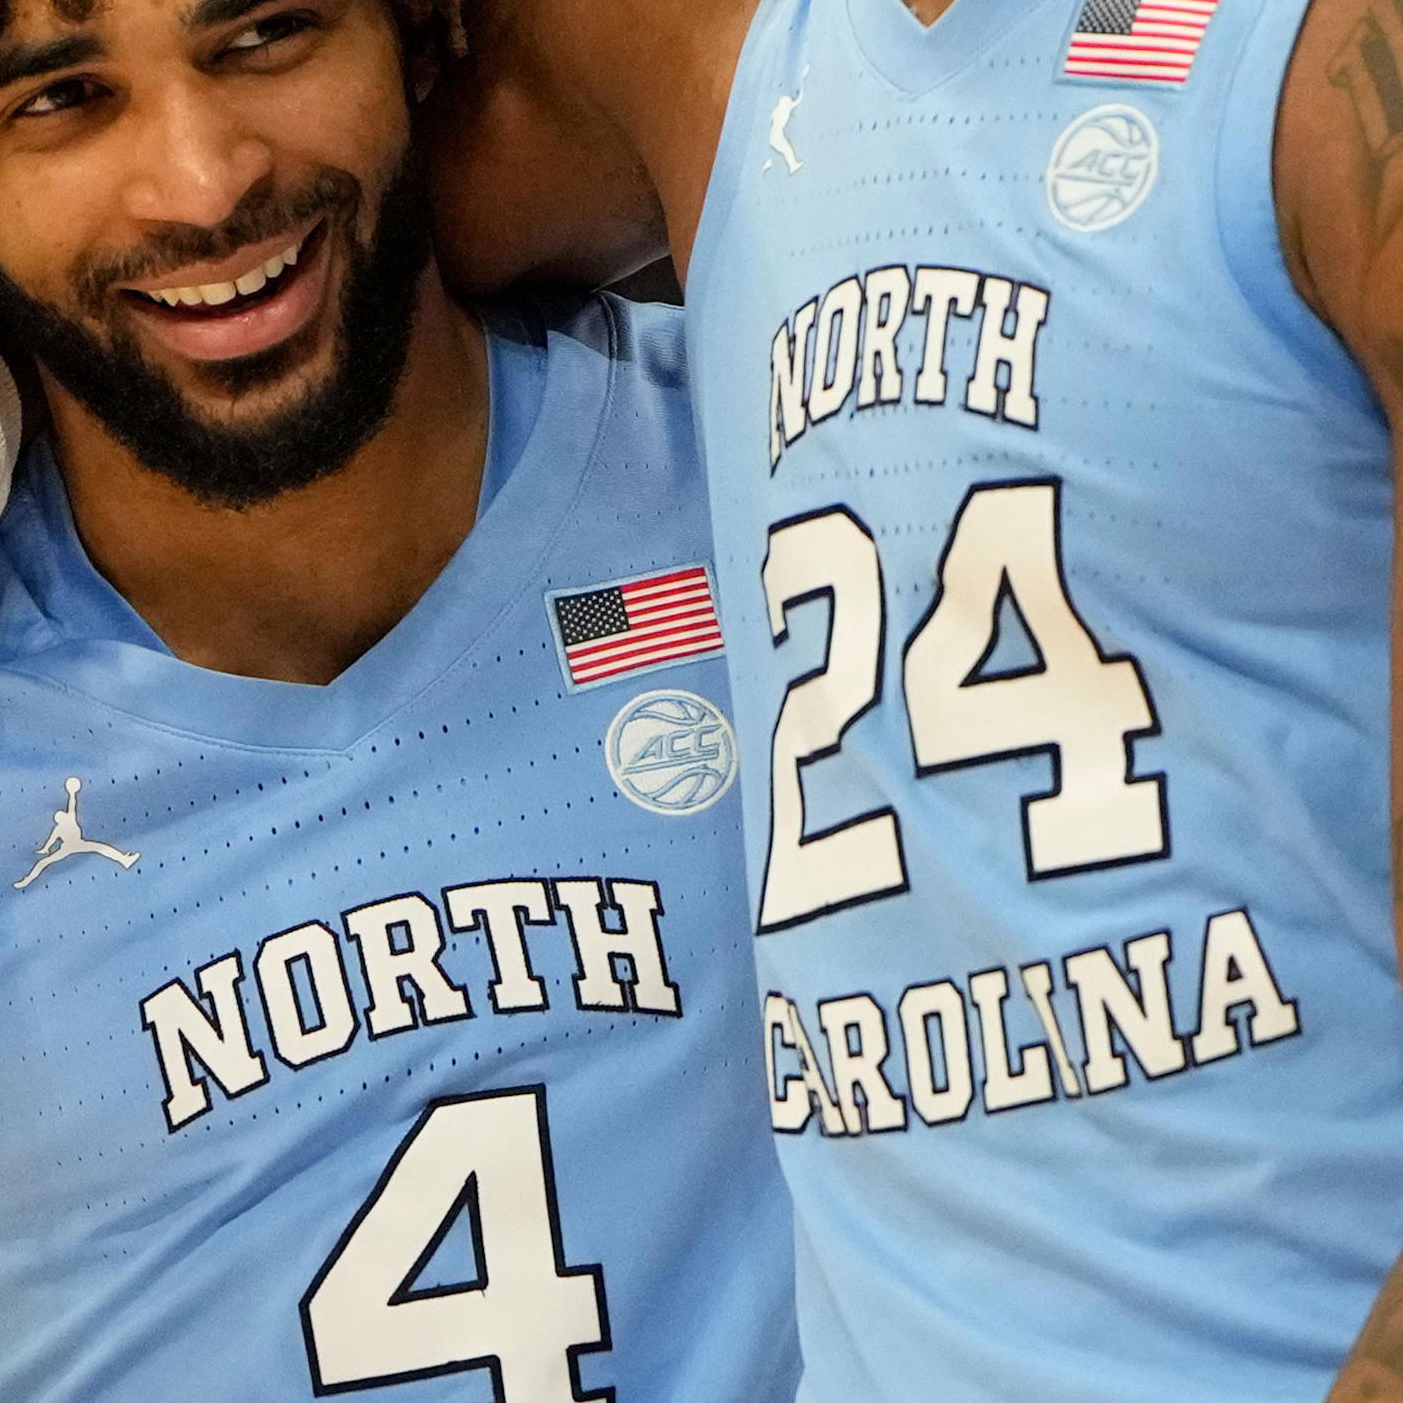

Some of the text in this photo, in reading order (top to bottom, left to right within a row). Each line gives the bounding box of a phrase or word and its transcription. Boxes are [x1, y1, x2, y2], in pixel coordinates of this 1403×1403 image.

[1070, 149, 1148, 179] ACC
[768, 263, 1051, 477] NORTH
[631, 724, 722, 763] ACC
[754, 476, 1173, 936] 24
[139, 876, 683, 1133] NORTH
[763, 906, 1302, 1138] CAROLINA
[298, 1082, 616, 1403] 4
